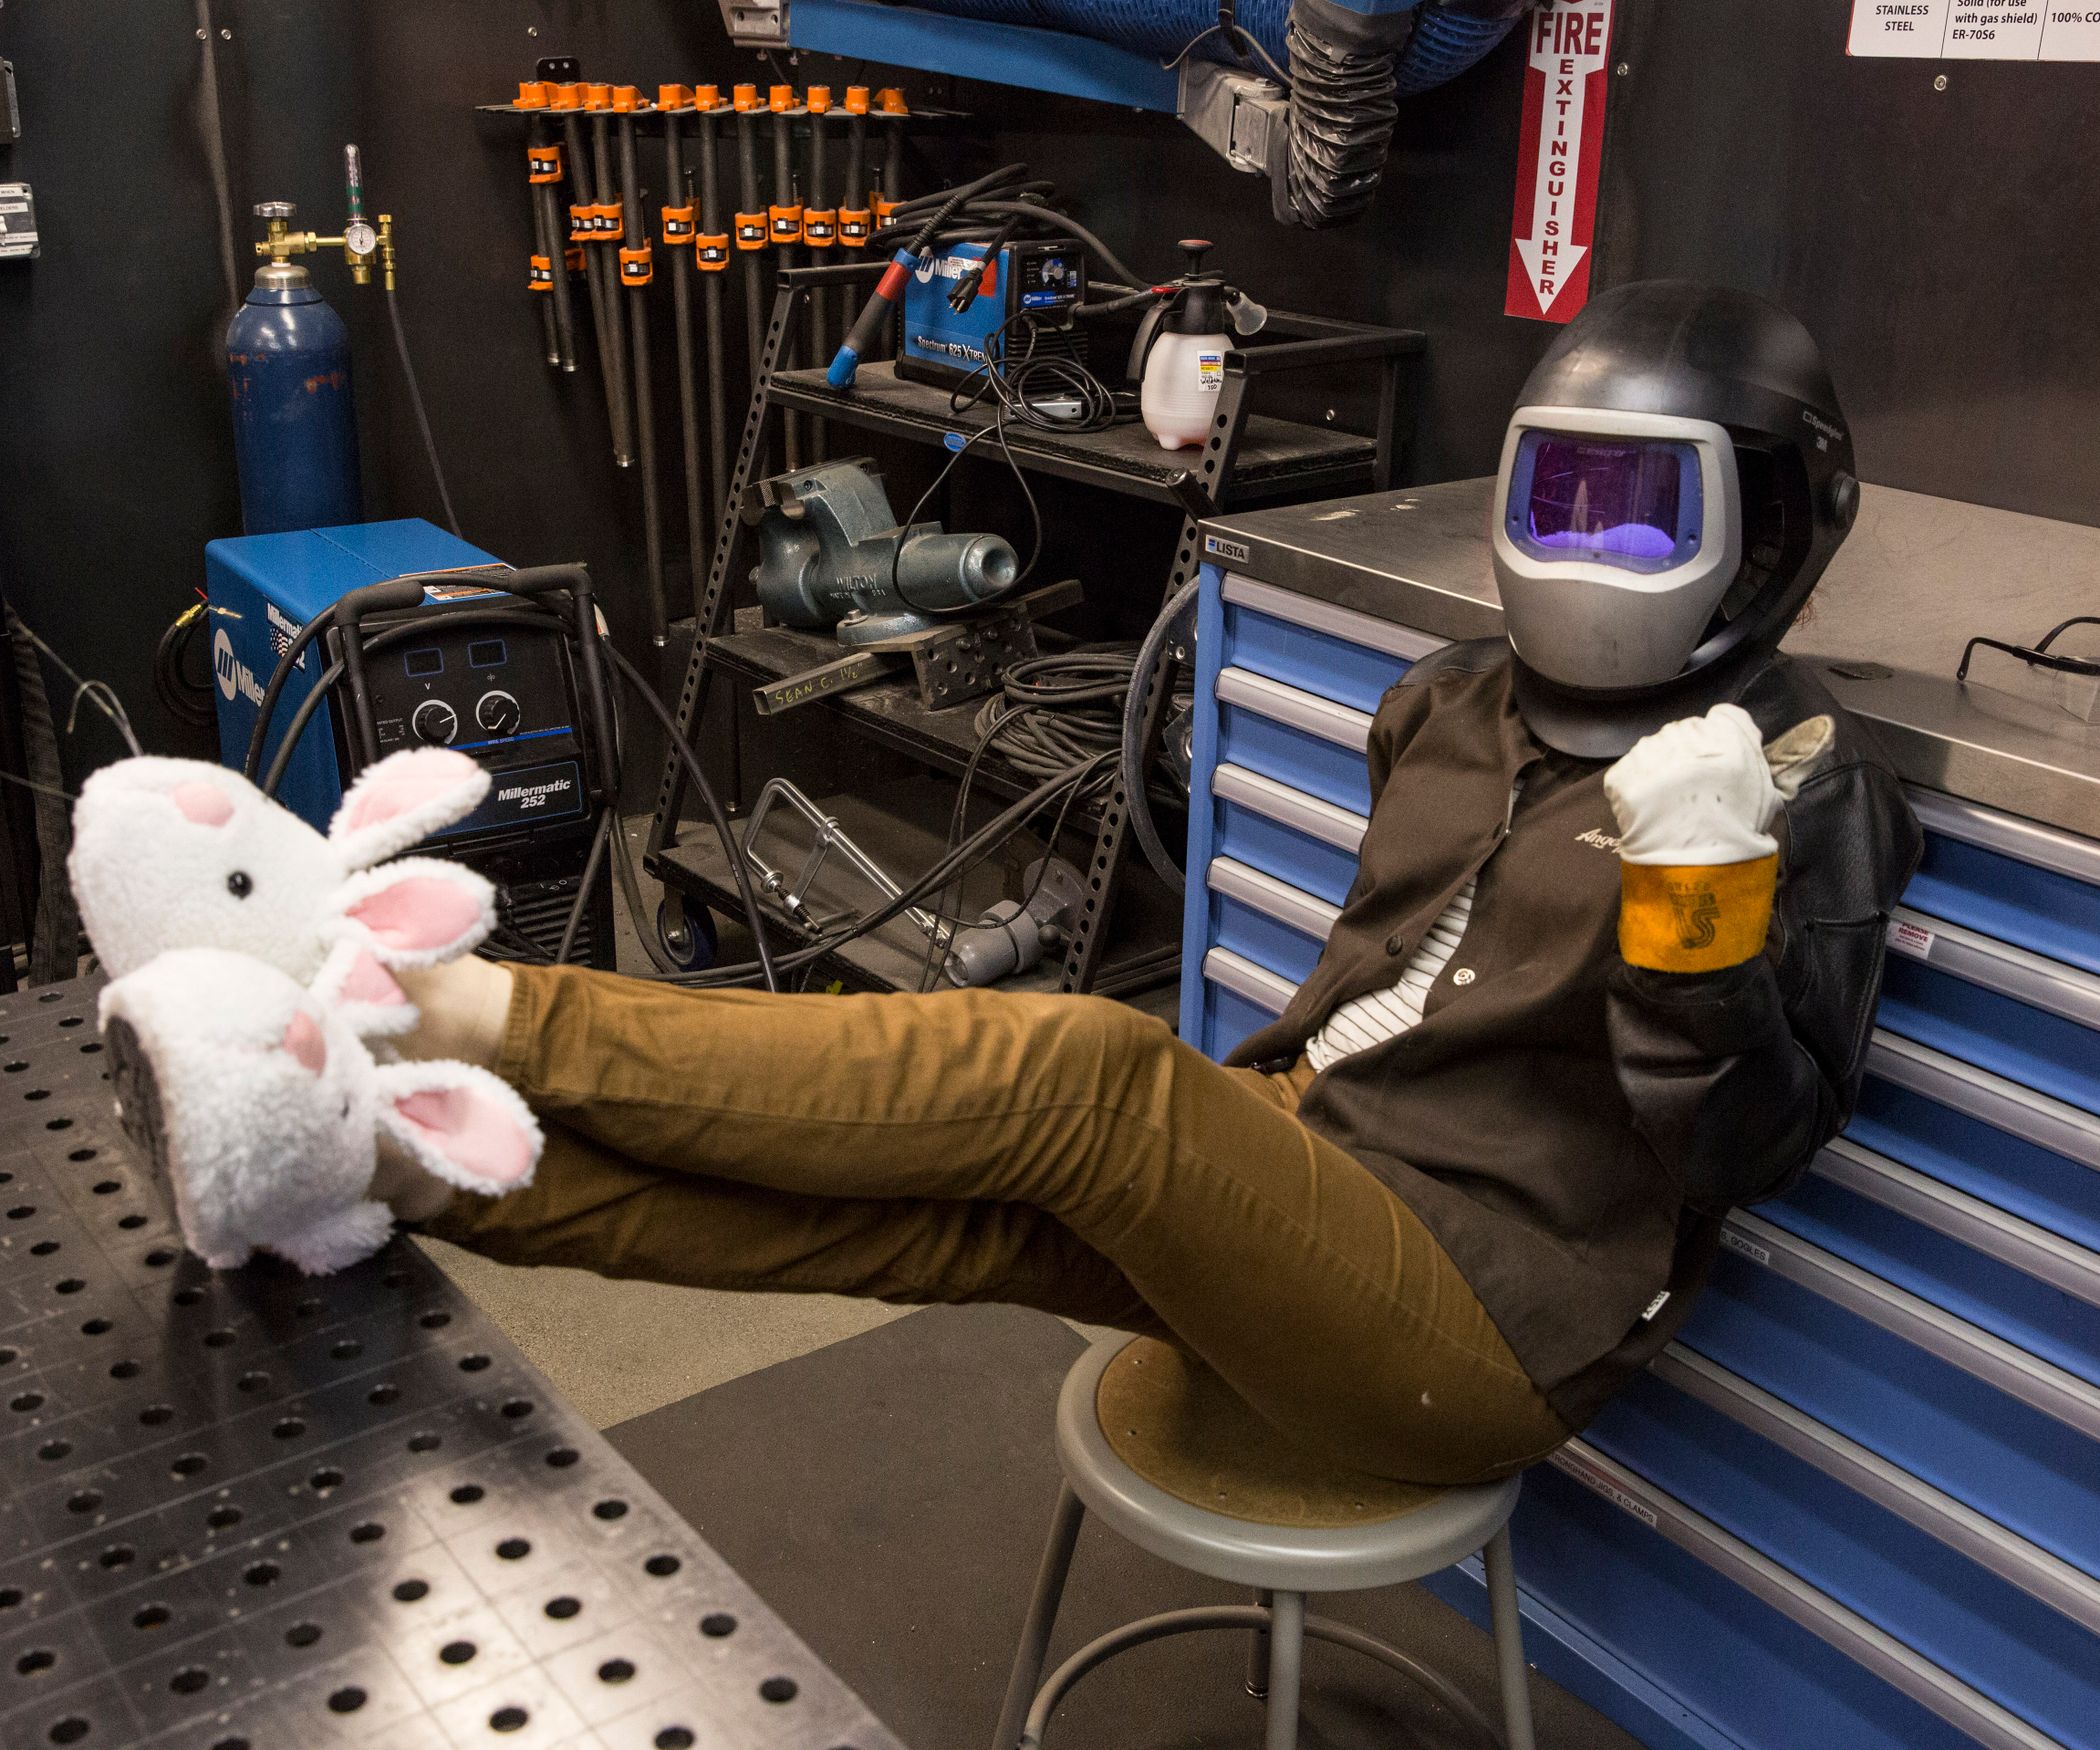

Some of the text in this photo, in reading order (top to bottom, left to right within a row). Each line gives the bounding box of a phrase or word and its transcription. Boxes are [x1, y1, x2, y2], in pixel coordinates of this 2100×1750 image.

[1875, 5, 1929, 15] STAINLESS
[2052, 12, 2083, 23] 100%
[1884, 21, 1915, 31] STEEL
[1955, 12, 2038, 26] with gas shield)
[1536, 12, 1604, 55] FIRE
[1952, 29, 1995, 40] ER-70S6
[1539, 59, 1574, 296] EXTINGUISHER
[917, 335, 946, 353] Spectrum
[948, 343, 962, 358] 625
[1216, 541, 1245, 559] LISTA
[836, 574, 878, 591] WILTON
[235, 660, 266, 707] Mille
[775, 679, 813, 705] SEAN
[498, 780, 571, 802] Millermatic
[521, 795, 546, 809] 252
